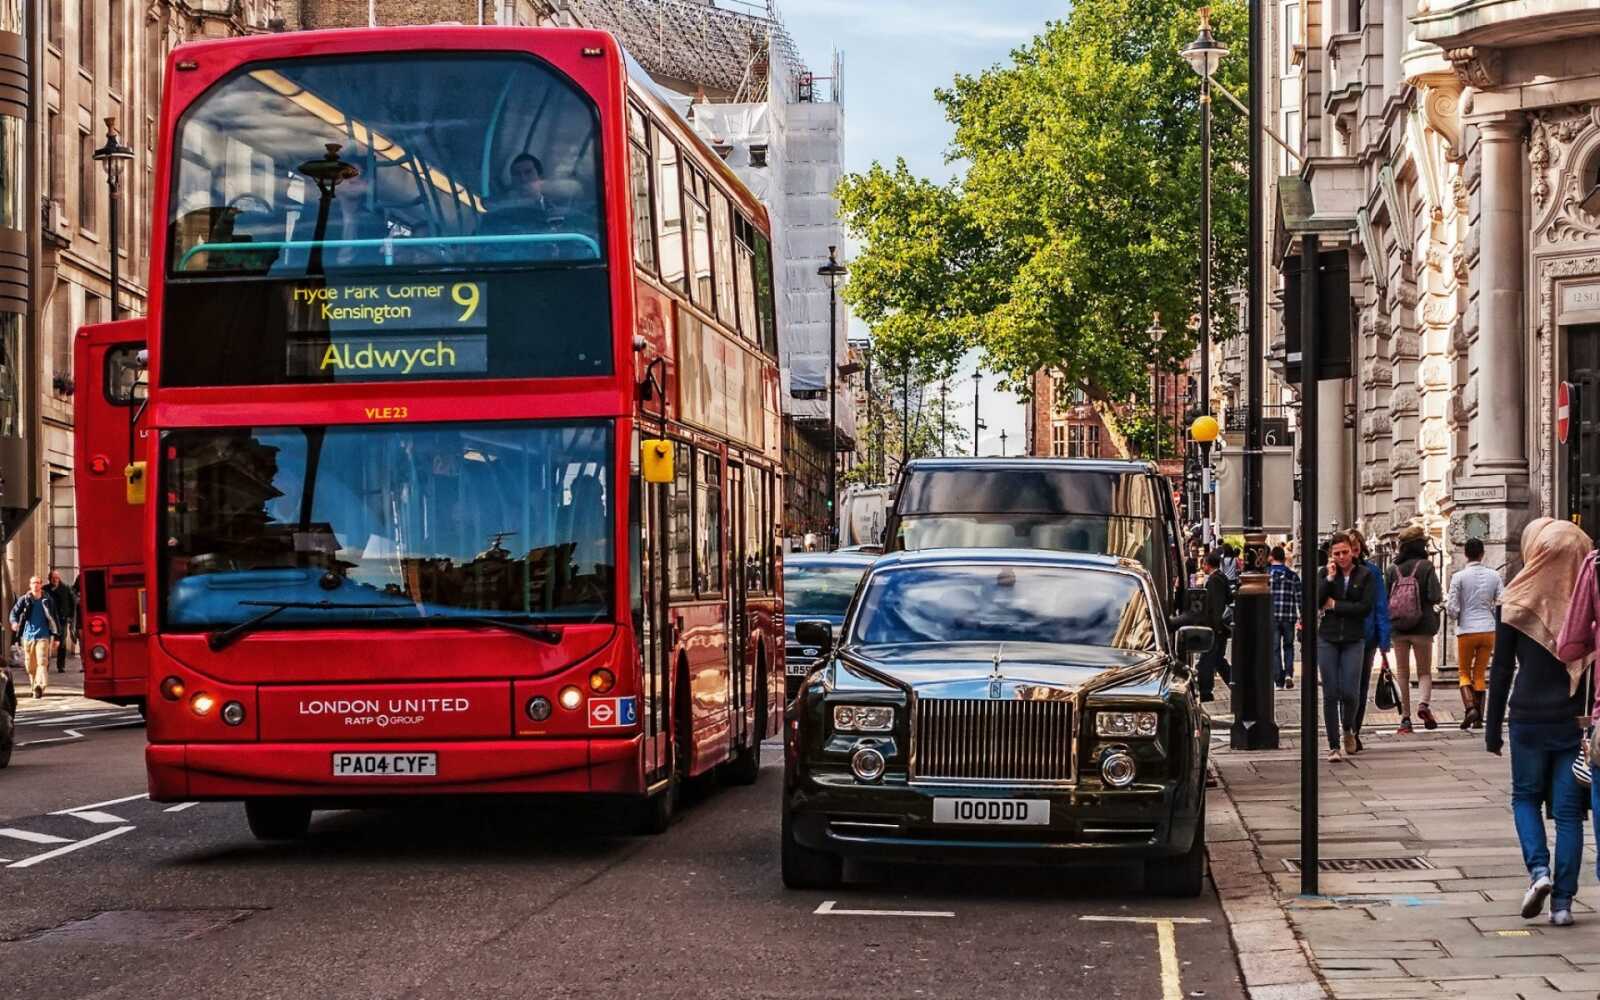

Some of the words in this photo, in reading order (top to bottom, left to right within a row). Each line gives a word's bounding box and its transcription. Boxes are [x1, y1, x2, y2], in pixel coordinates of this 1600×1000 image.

[451, 282, 480, 322] 9
[321, 303, 412, 324] Kensington
[320, 341, 456, 375] Aldwych
[364, 406, 408, 419] VLE23
[1265, 429, 1276, 446] 6
[299, 700, 379, 714] LONDON
[389, 698, 470, 713] UNITED
[344, 716, 374, 725] RATP
[389, 715, 424, 725] GROUP
[340, 756, 389, 773] PA04
[393, 756, 429, 772] CYF
